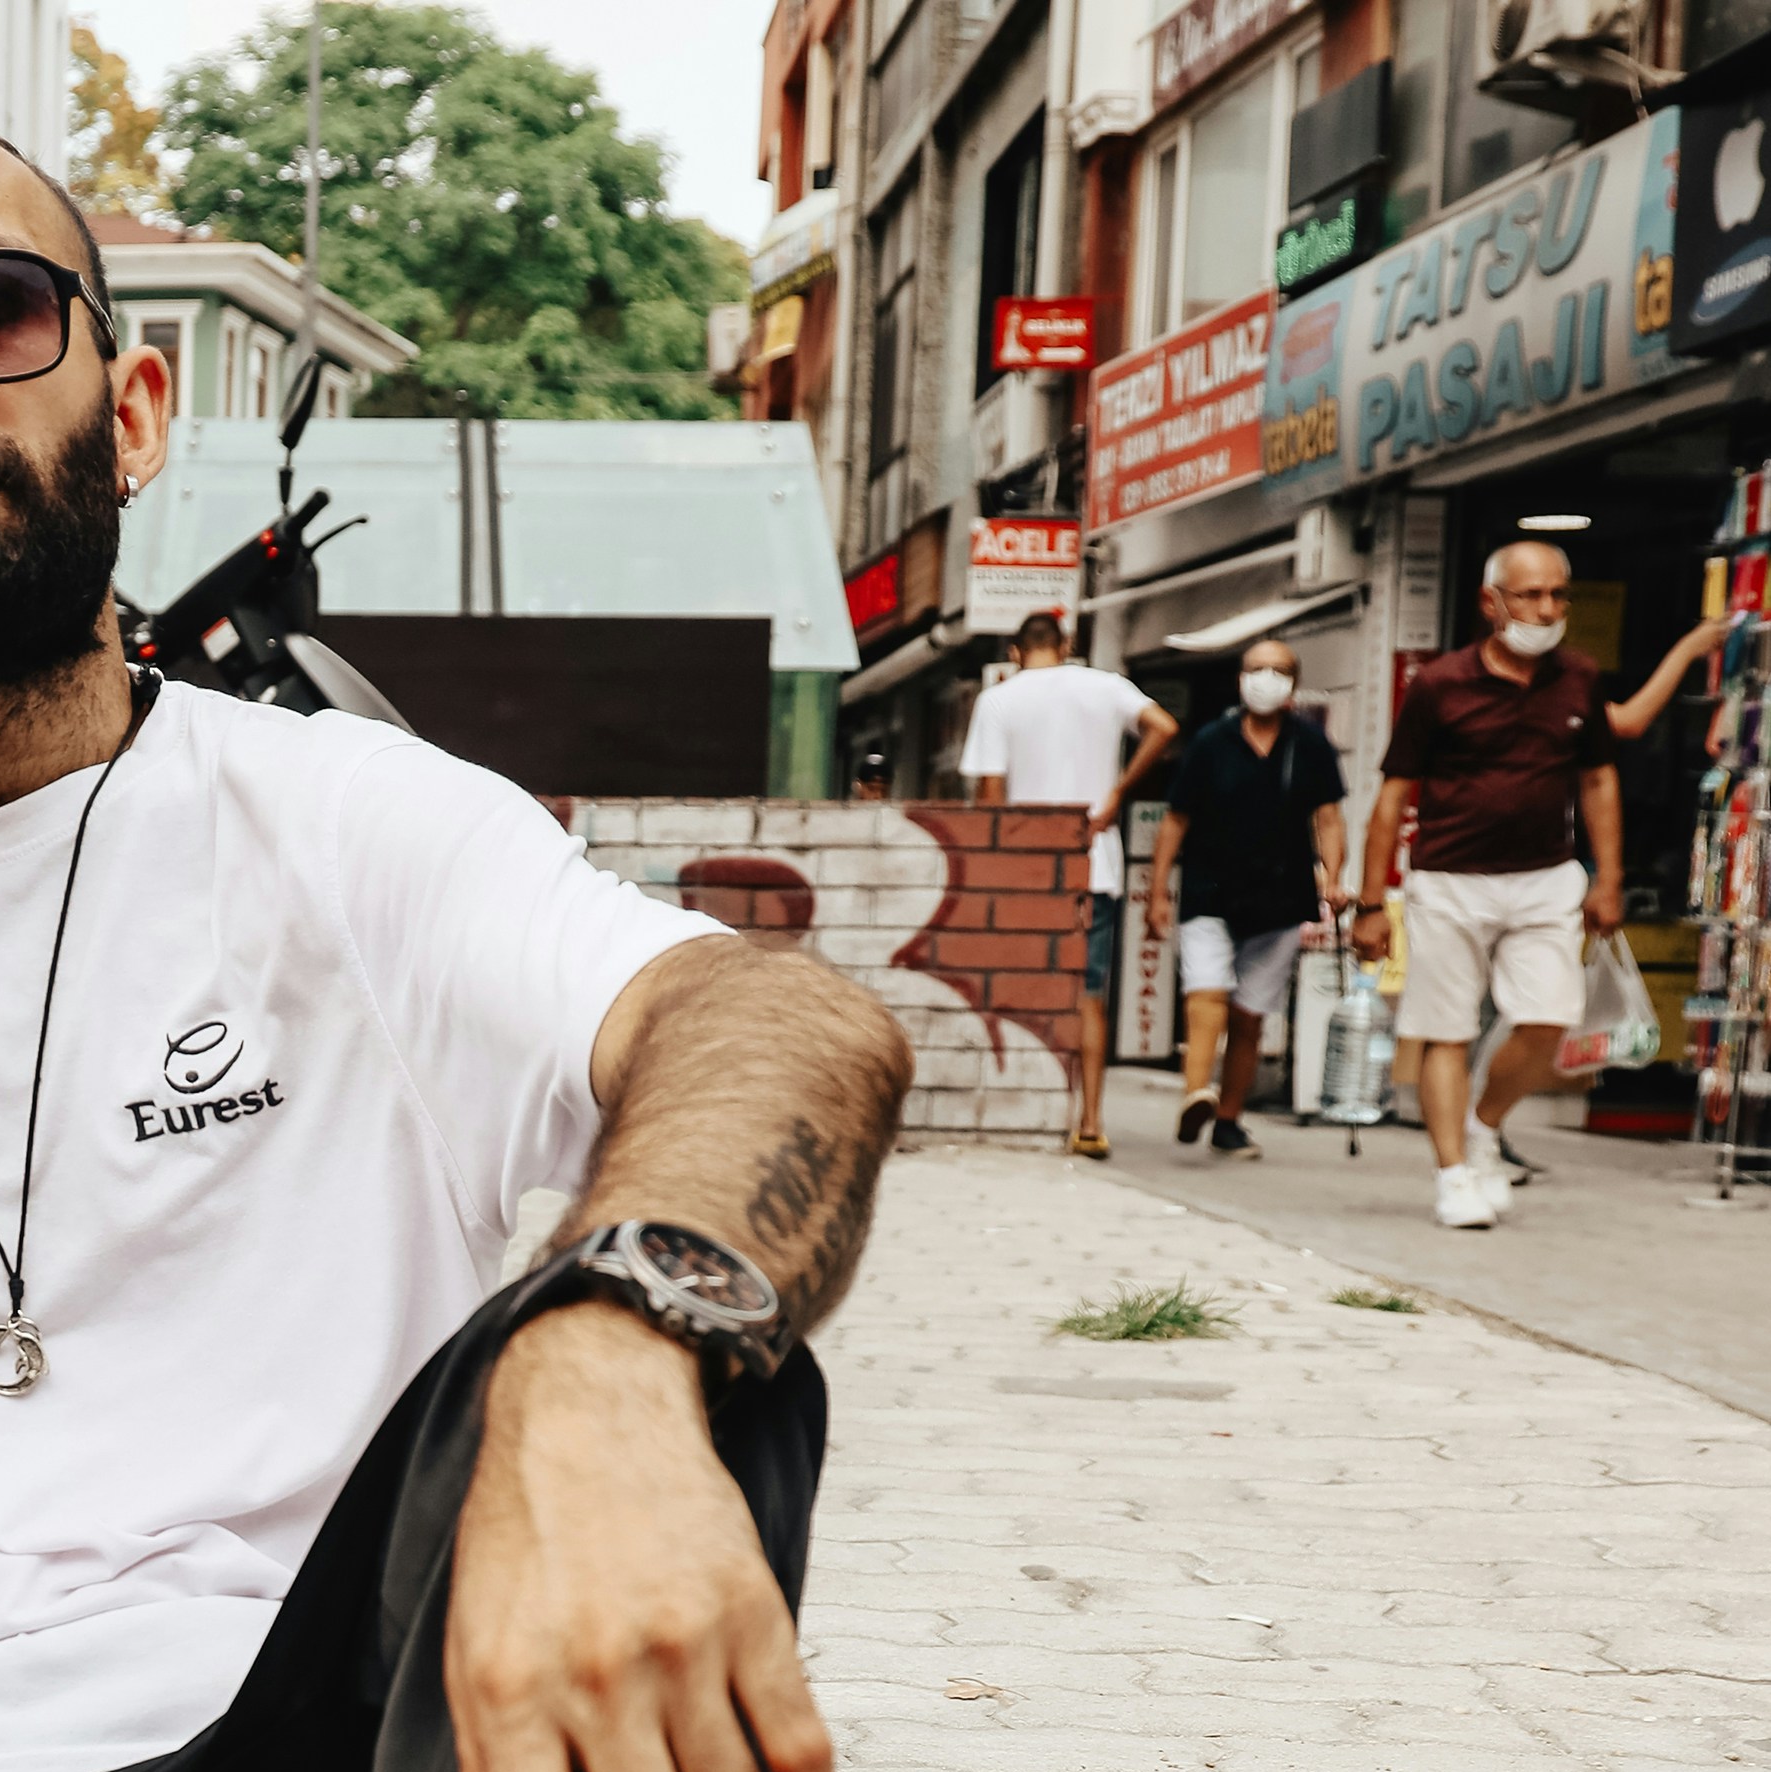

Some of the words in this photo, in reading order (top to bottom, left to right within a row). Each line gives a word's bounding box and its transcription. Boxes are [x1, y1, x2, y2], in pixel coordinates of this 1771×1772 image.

[1372, 153, 1608, 352] TATSU
[1167, 312, 1270, 404] YILMAZ
[1358, 280, 1608, 473] PASAJI
[973, 526, 1078, 563] ACELE
[124, 1078, 286, 1143] Eurest
